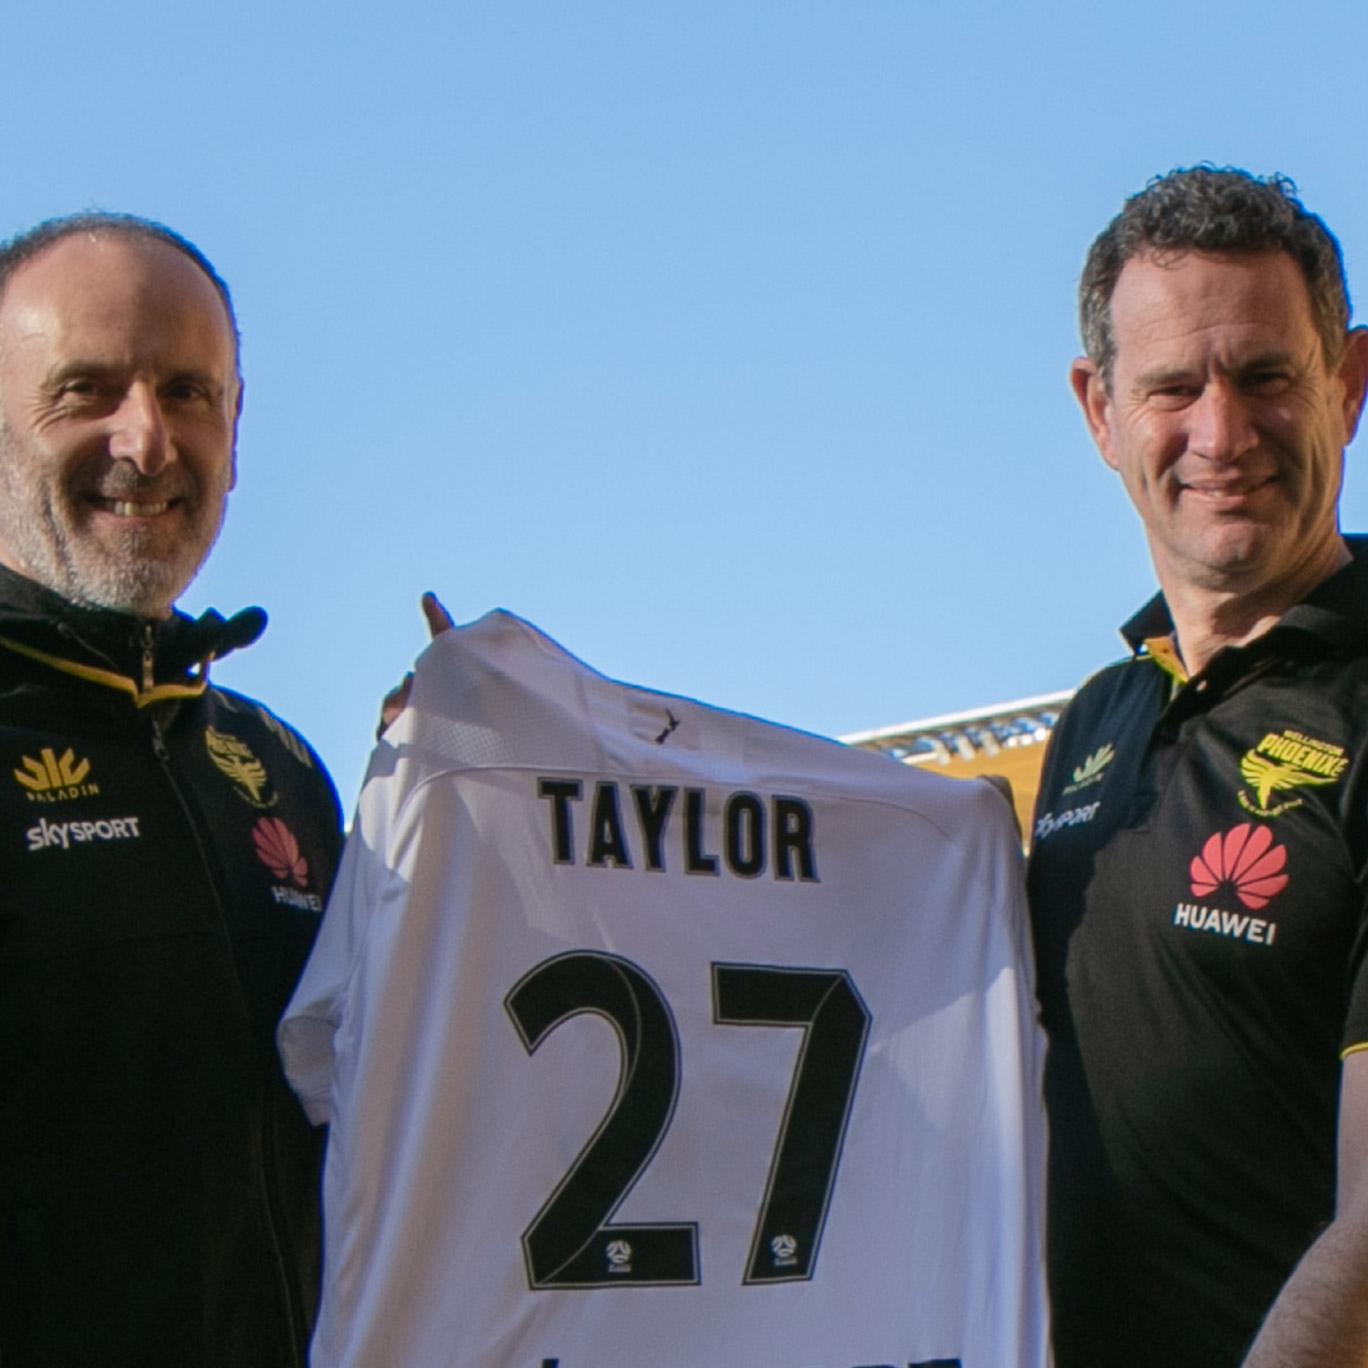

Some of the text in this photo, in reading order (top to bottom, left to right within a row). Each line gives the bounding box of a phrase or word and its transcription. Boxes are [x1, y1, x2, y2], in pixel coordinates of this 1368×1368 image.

[1256, 731, 1340, 777] PHOENIX
[536, 776, 821, 884] TAYLOR
[1173, 902, 1277, 946] HUAWEI
[502, 948, 874, 1291] 27
